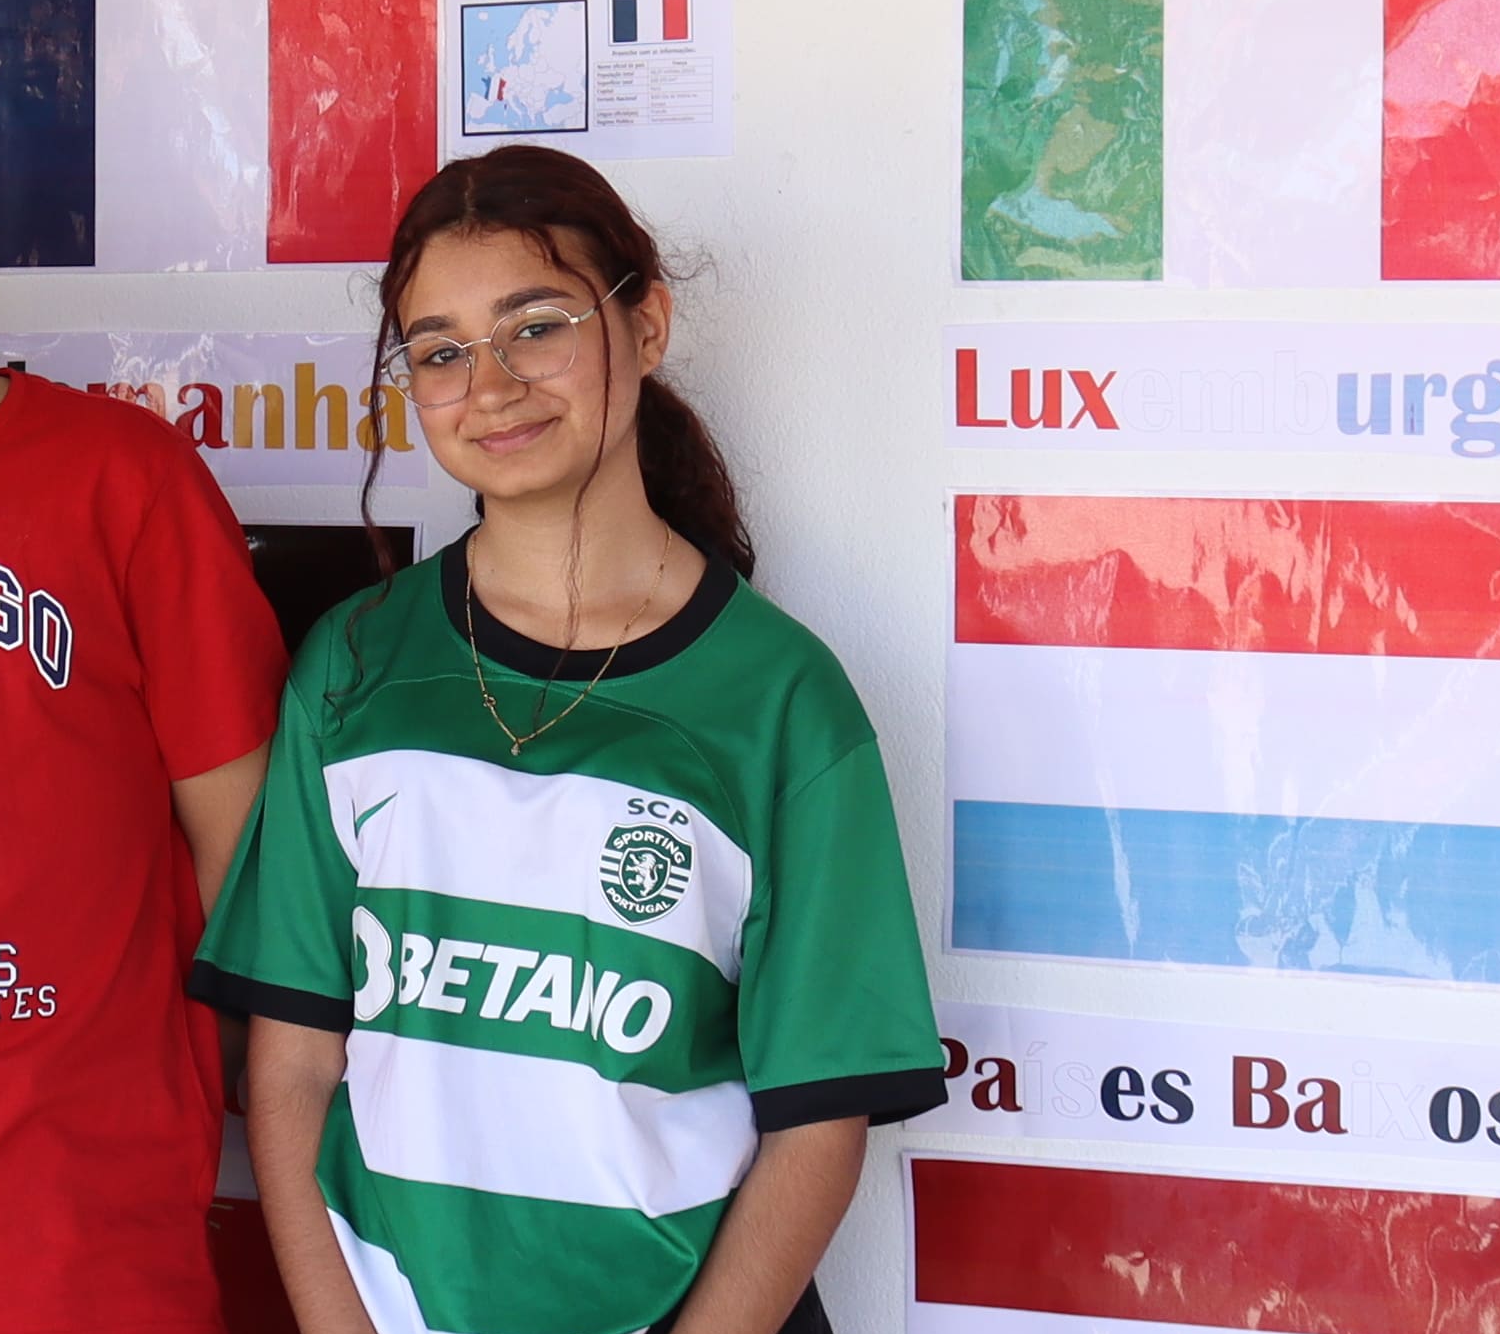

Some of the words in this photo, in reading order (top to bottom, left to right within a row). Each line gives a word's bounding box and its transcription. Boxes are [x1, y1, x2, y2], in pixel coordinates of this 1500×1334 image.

[627, 798, 689, 825] SCP
[613, 831, 686, 864] SPORTING
[606, 887, 670, 913] PORTUGAL
[398, 932, 673, 1054] BETANO
